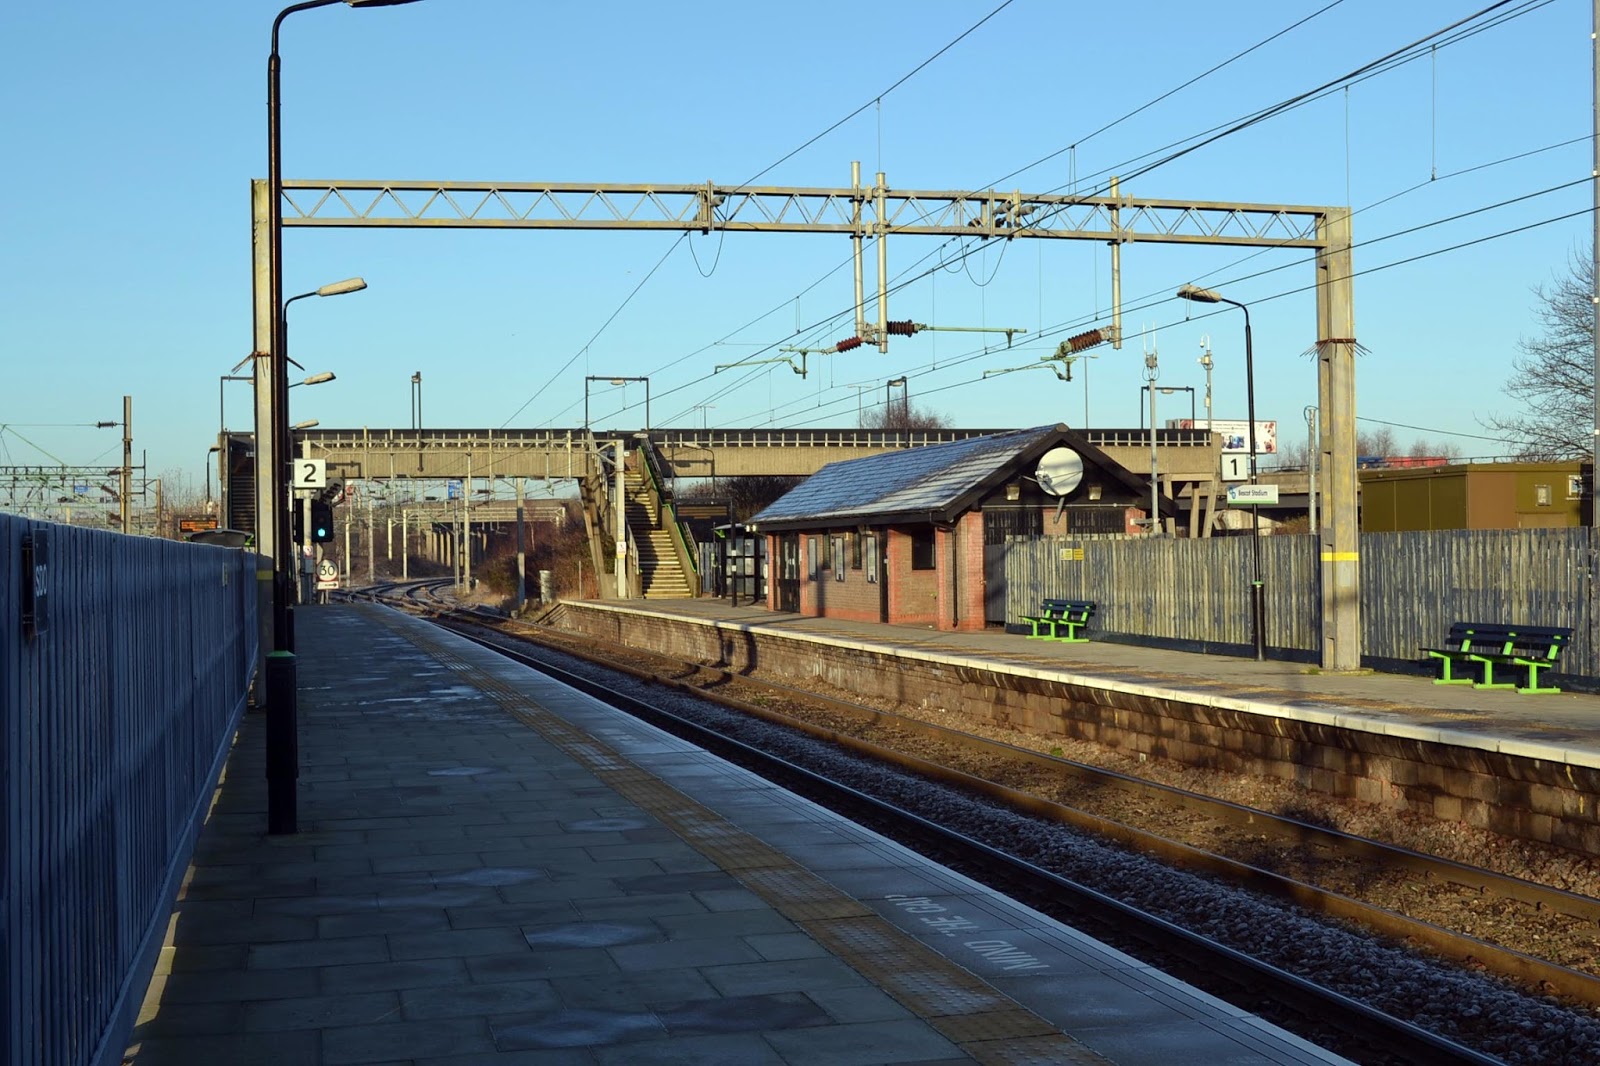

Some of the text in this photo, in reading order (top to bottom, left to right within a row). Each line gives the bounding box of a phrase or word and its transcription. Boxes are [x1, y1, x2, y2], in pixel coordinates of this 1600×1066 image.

[303, 463, 317, 483] 2
[1230, 458, 1238, 476] 1
[1251, 489, 1268, 497] Stadium
[319, 565, 335, 576] 30
[963, 940, 1050, 971] MIND
